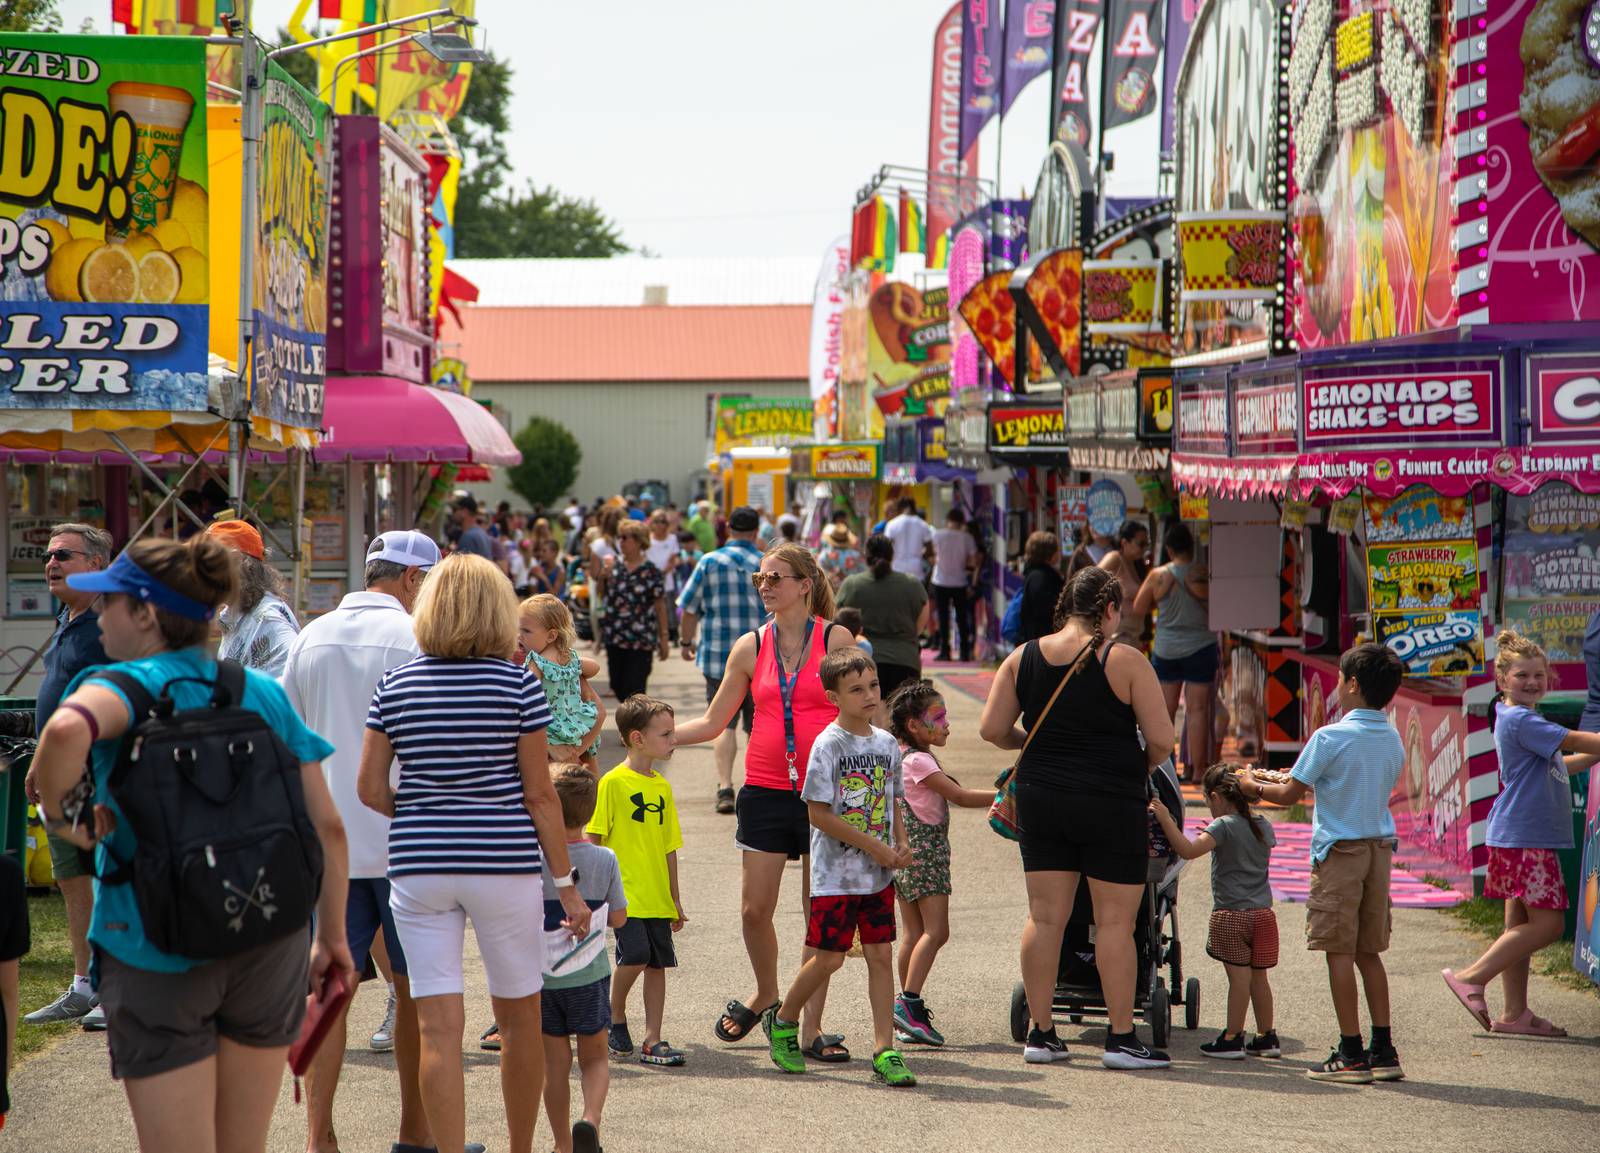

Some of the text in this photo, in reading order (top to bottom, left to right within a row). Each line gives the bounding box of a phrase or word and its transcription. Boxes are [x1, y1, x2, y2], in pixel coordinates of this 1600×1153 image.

[1310, 379, 1473, 406] LEMONADE
[1237, 394, 1274, 434] ELEPHANT
[1309, 403, 1480, 432] SHAKE-UPS
[1398, 458, 1489, 476] FUNNEL CAKES
[1522, 456, 1589, 473] ELEPHANT
[1388, 548, 1457, 565] STRAWBERRY
[1382, 562, 1466, 582] LEMONADE
[1384, 614, 1446, 636] DEEP FRIED
[1386, 622, 1473, 657] OREO
